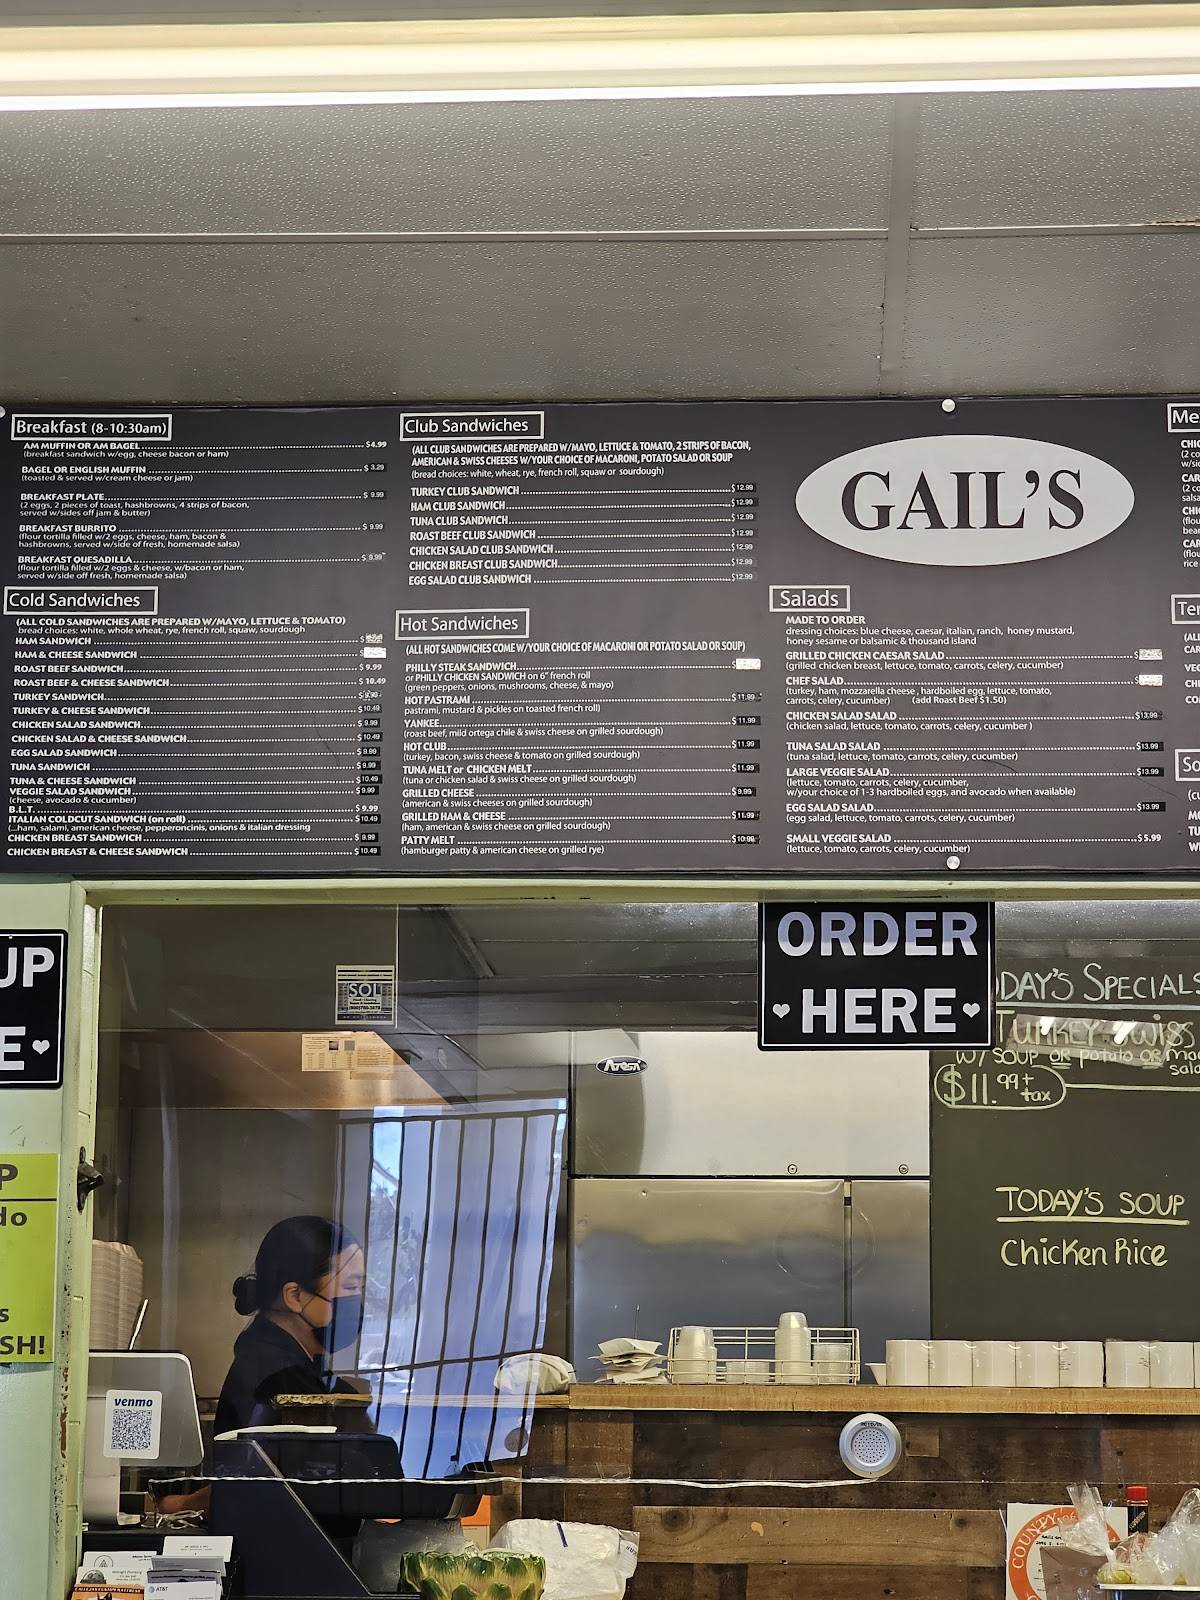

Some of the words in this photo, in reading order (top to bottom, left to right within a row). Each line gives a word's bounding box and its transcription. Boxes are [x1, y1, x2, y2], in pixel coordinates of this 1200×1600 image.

[15, 420, 87, 433] Breakfast
[91, 422, 167, 435] (8-10:30am)
[404, 419, 438, 433] Club
[442, 418, 528, 432] Sandwiches
[411, 469, 436, 479] (bread
[438, 469, 468, 478] choices:
[470, 469, 493, 478] white,
[495, 468, 521, 477] wheat,
[522, 470, 536, 478] rye,
[538, 468, 562, 476] french
[564, 468, 579, 476] roll,
[580, 469, 606, 477] squaw
[619, 467, 664, 477] sourdough)
[411, 486, 445, 496] TURKEY
[446, 486, 470, 496] CLUB
[471, 485, 520, 495] SANDWICH
[841, 469, 1084, 531] GAIL'S
[74, 524, 116, 532] BURRITO
[18, 555, 72, 563] BREAKFAST
[408, 575, 426, 585] EGG
[427, 575, 457, 585] SALAD
[458, 575, 481, 584] CLUB
[482, 574, 531, 584] SANDWICH
[9, 592, 44, 606] Cold
[49, 592, 140, 607] Sandwiches
[780, 590, 838, 606] Salads
[16, 618, 36, 626] (ALL
[67, 618, 130, 626] SANDWICHES
[151, 617, 201, 625] PREPARED
[201, 617, 249, 626] W/MAYO,
[250, 616, 290, 625] LETTUCE
[291, 616, 300, 624] &
[301, 616, 346, 625] TOMATO)
[400, 617, 427, 631] Hot
[431, 616, 518, 631] Sandwiches
[785, 615, 814, 624] MADE
[815, 615, 829, 624] TO
[831, 615, 865, 624] ORDER
[39, 637, 91, 645] SANDWICH
[786, 636, 813, 646] honey
[860, 636, 898, 645] balsamic
[899, 636, 906, 645] &
[908, 636, 949, 645] thousand
[951, 636, 976, 644] island
[785, 651, 826, 660] GRILLED
[828, 651, 871, 659] CHICKEN
[872, 651, 911, 660] CAESAR
[912, 651, 945, 660] SALAD
[405, 663, 437, 672] PHILLY
[438, 662, 466, 671] STEAK
[467, 662, 518, 671] SANDWICH
[51, 692, 104, 700] SANDWICH
[404, 695, 423, 704] HOT
[424, 695, 470, 704] PASTRAMI
[912, 696, 931, 704] (add
[958, 695, 978, 703] Beef
[979, 695, 1006, 704] $1.50)
[404, 719, 440, 727] YANKEE
[786, 741, 813, 750] TUNA
[814, 742, 847, 750] SALAD
[848, 741, 880, 750] SALAD
[37, 762, 90, 770] SANDWICH
[402, 788, 440, 797] GRILLED
[441, 788, 474, 797] CHEESE
[8, 805, 36, 813] B.L.T.
[8, 815, 46, 823] ITALIAN
[47, 815, 93, 823] COLDCUT
[94, 815, 146, 823] SANDWICH
[147, 815, 164, 823] (on
[165, 815, 187, 824] roll)
[51, 833, 88, 841] BREAST
[89, 833, 143, 841] SANDWICH
[401, 835, 429, 844] PATTY
[430, 835, 455, 844] MELT
[786, 834, 820, 843] SMALL
[821, 834, 857, 842] VEGGIE
[858, 834, 891, 843] SALAD
[401, 846, 448, 856] (hamburger
[449, 847, 470, 855] patty
[472, 846, 478, 854] &
[480, 846, 517, 854] american
[518, 845, 547, 853] cheese
[560, 845, 587, 855] grilled
[588, 845, 604, 855] rye)
[786, 844, 822, 853] (lettuce,
[823, 845, 858, 853] tomato,
[860, 845, 892, 853] carrots,
[893, 844, 921, 854] celery,
[923, 844, 970, 853] cucumber)
[777, 911, 978, 956] ORDER
[349, 984, 382, 997] SOL
[802, 988, 957, 1034] HERE
[1114, 1014, 1196, 1048] wiss
[992, 1048, 1039, 1065] SOUP
[1020, 1087, 1051, 1102] tax
[996, 1186, 1104, 1217] TODAY'S
[1119, 1191, 1185, 1216] SOUP
[1115, 1237, 1168, 1267] Rice
[114, 1398, 153, 1407] venmo
[1012, 1512, 1058, 1569] COUNTY
